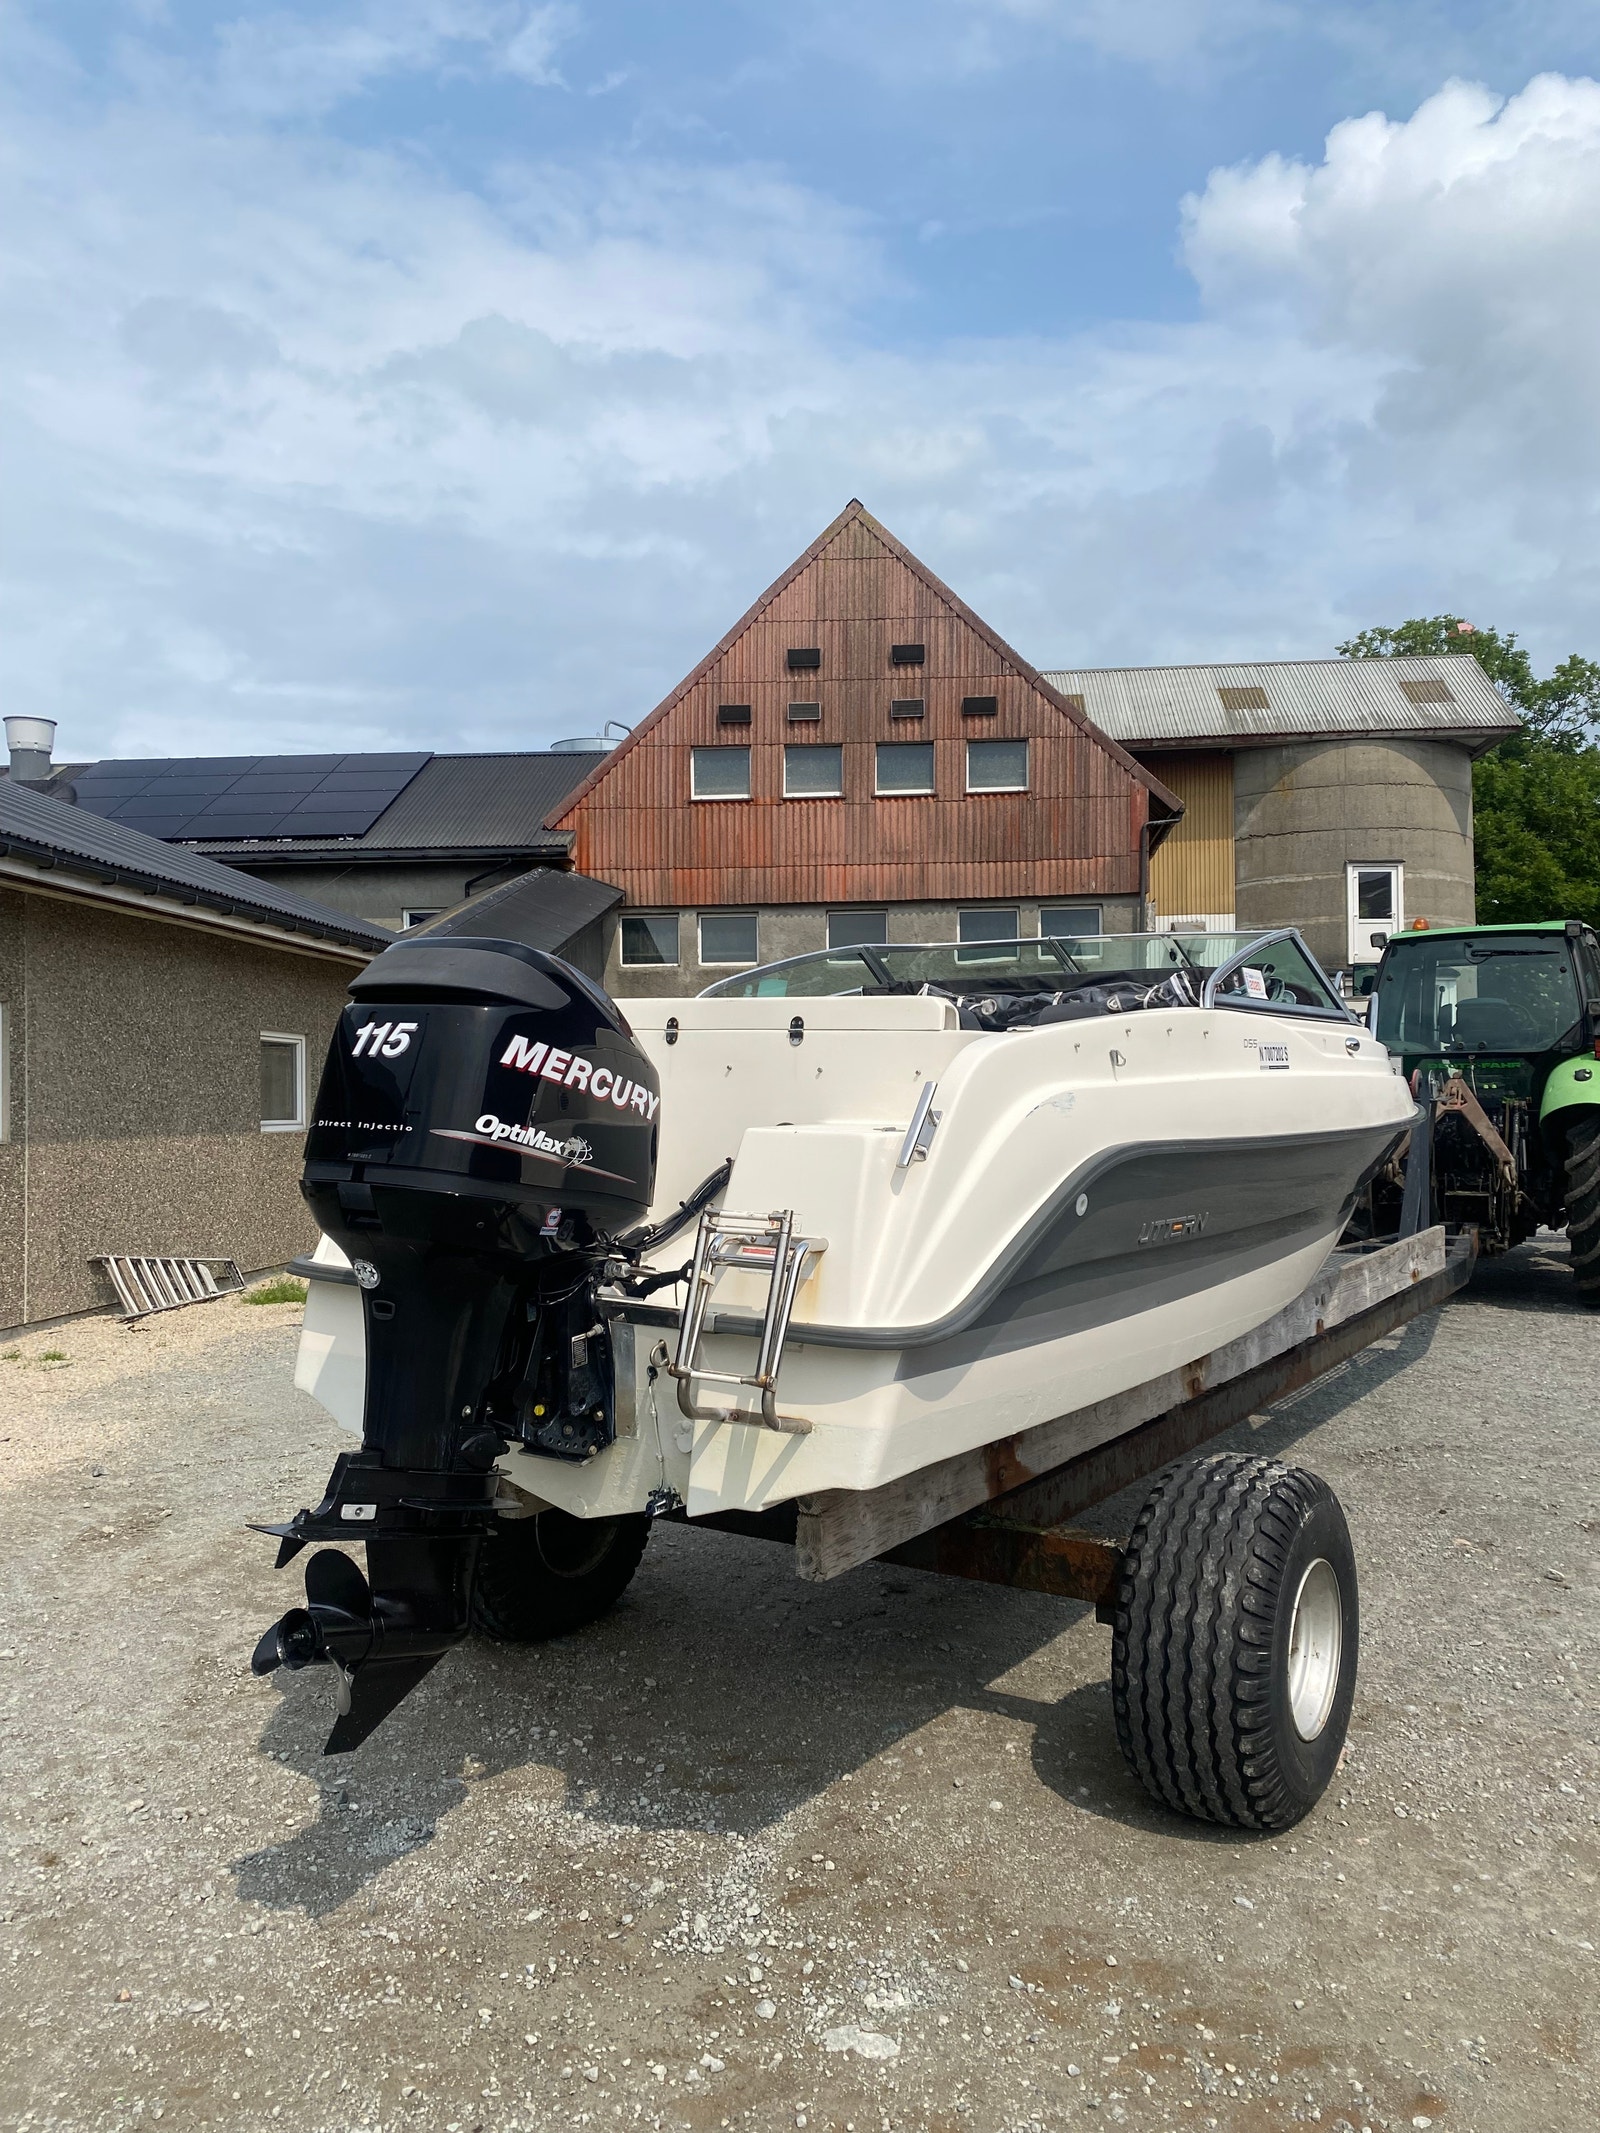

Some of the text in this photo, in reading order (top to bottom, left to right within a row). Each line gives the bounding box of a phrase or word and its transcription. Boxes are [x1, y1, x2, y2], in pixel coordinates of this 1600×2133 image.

[351, 1022, 419, 1058] 115
[500, 1034, 660, 1123] MERCURY
[475, 1114, 566, 1156] OptiMax
